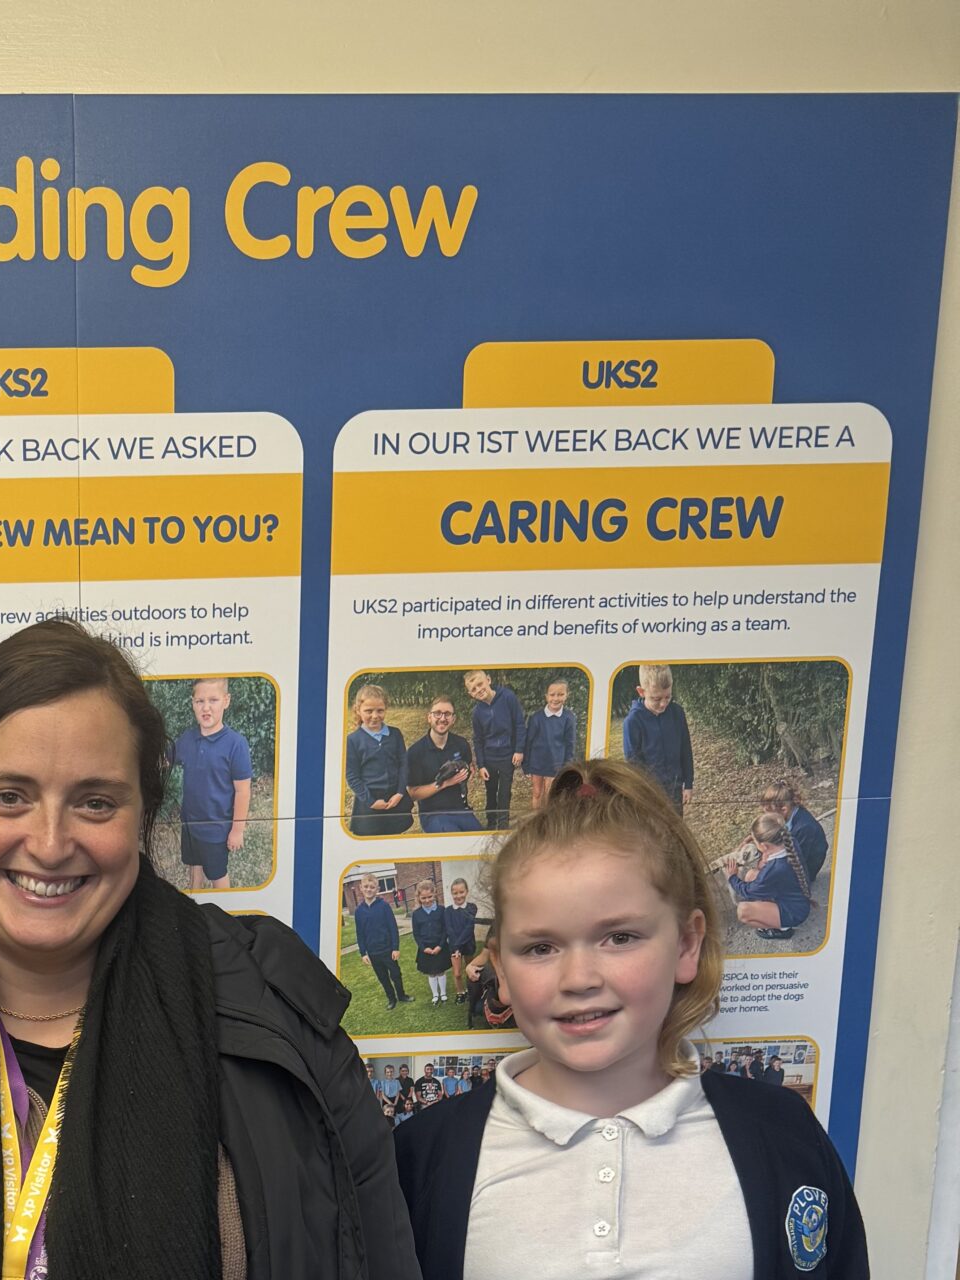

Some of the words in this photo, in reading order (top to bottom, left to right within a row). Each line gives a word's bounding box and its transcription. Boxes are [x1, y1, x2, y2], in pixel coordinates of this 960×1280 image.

[225, 162, 478, 259] Crew
[583, 360, 658, 389] UKS2
[23, 438, 100, 461] BACK
[108, 437, 154, 459] WE
[162, 436, 256, 459] ASKED
[374, 433, 399, 455] IN
[409, 432, 469, 454] OUR
[477, 431, 519, 453] 1ST
[525, 430, 607, 452] WEEK
[615, 428, 689, 451] BACK
[697, 428, 741, 449] WE
[749, 426, 830, 448] WERE
[836, 426, 855, 447] A
[43, 517, 135, 547] MEAN
[143, 516, 185, 544] TO
[193, 514, 279, 543] YOU?
[441, 498, 628, 545] CARING
[647, 496, 784, 541] CREW
[36, 606, 107, 624] activities
[112, 605, 186, 621] outdoors
[191, 606, 207, 618] to
[213, 603, 248, 621] help
[354, 599, 397, 614] UKS2
[403, 596, 501, 616] participated
[507, 596, 521, 610] in
[526, 595, 595, 609] different
[599, 592, 668, 608] activities
[673, 594, 688, 606] to
[693, 591, 728, 609] help
[733, 588, 825, 605] understand
[830, 588, 856, 602] the
[150, 632, 161, 647] is
[166, 631, 252, 649] important.
[418, 624, 513, 642] importance
[517, 621, 548, 636] and
[554, 619, 618, 635] benefits
[622, 619, 639, 633] of
[642, 618, 706, 635] working
[711, 621, 727, 631] as
[746, 618, 790, 630] team.
[761, 971, 777, 980] visit
[779, 970, 798, 980] their
[765, 982, 809, 992] persuasive
[739, 1004, 769, 1013] homes.
[741, 994, 765, 1004] adopt
[768, 992, 782, 1001] the
[783, 992, 804, 1002] dogs
[27, 1152, 52, 1199] Visitor
[22, 1199, 37, 1218] XP
[792, 1189, 827, 1216] PLOVE
